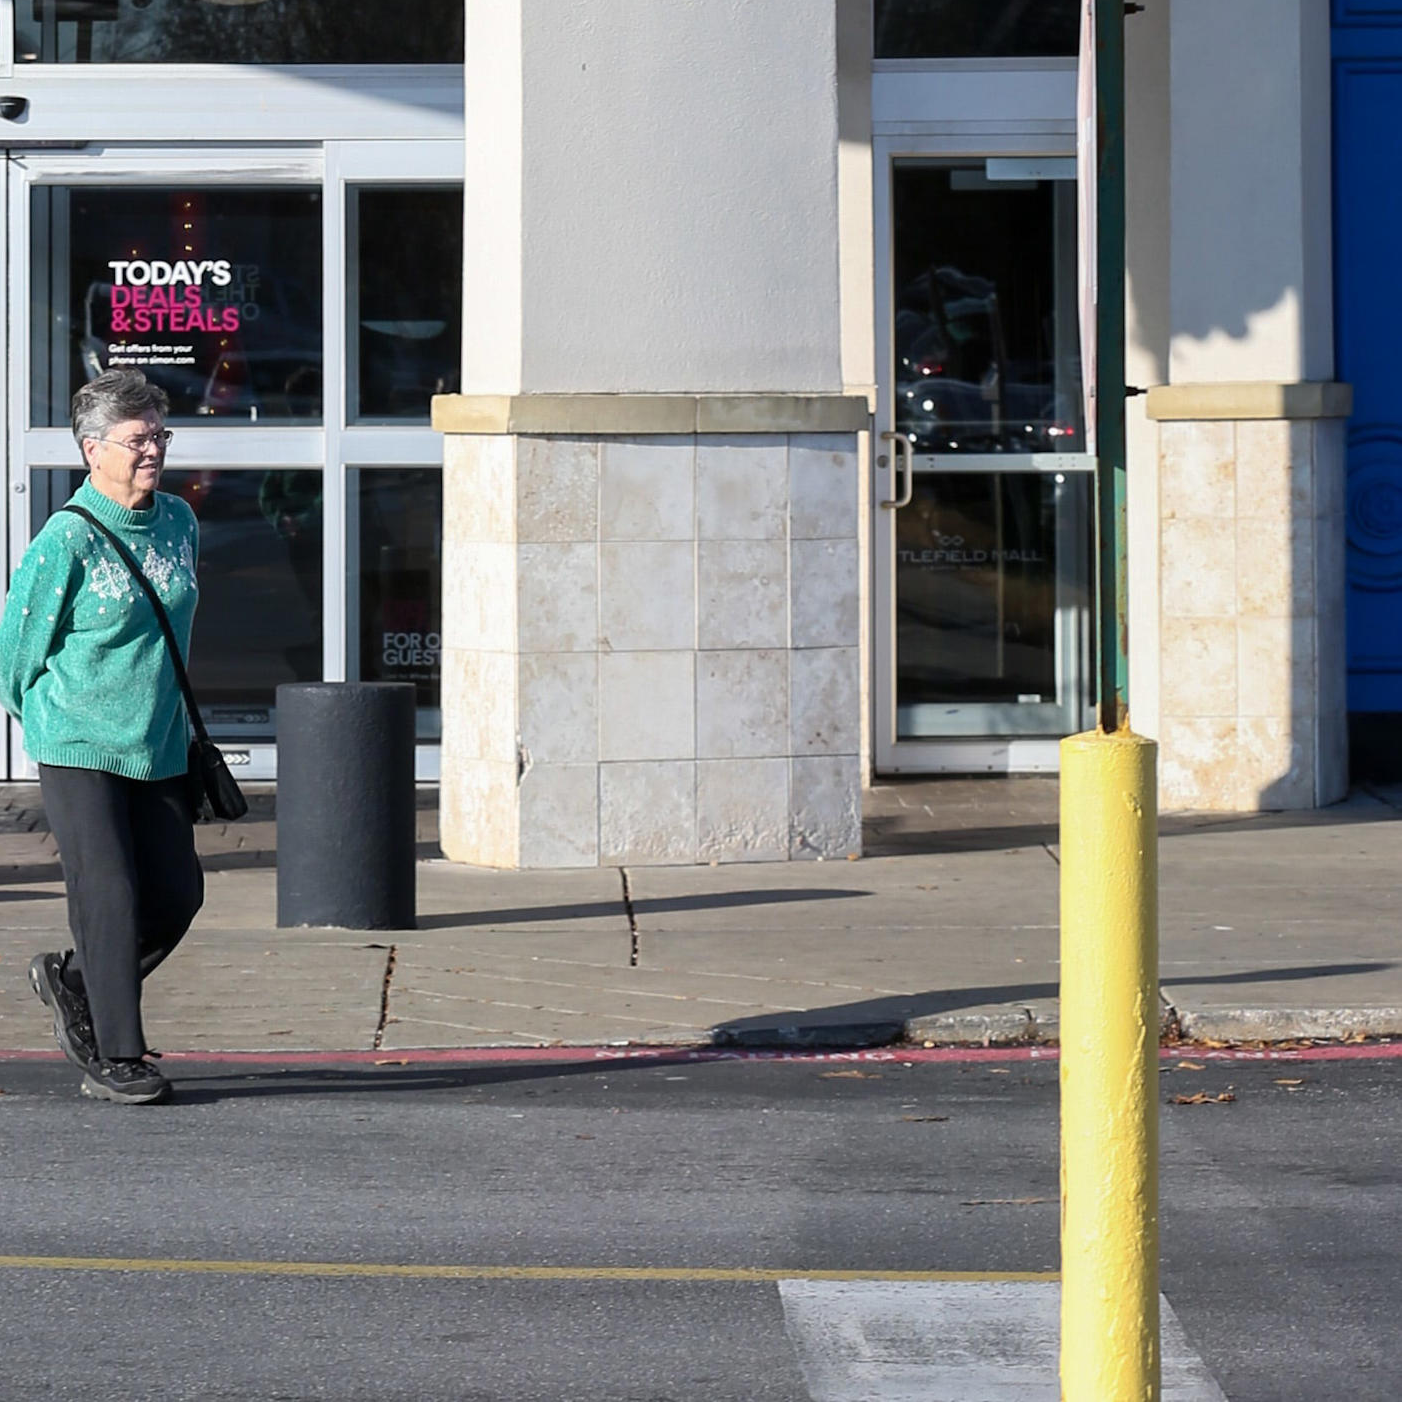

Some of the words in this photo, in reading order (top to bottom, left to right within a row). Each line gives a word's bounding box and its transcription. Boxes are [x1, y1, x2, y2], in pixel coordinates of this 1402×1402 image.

[108, 260, 232, 286] TODAY'S
[111, 286, 202, 309] DEALS
[134, 308, 240, 332] STEALS
[897, 549, 988, 563] TLEFIELD
[383, 632, 421, 649] FOR
